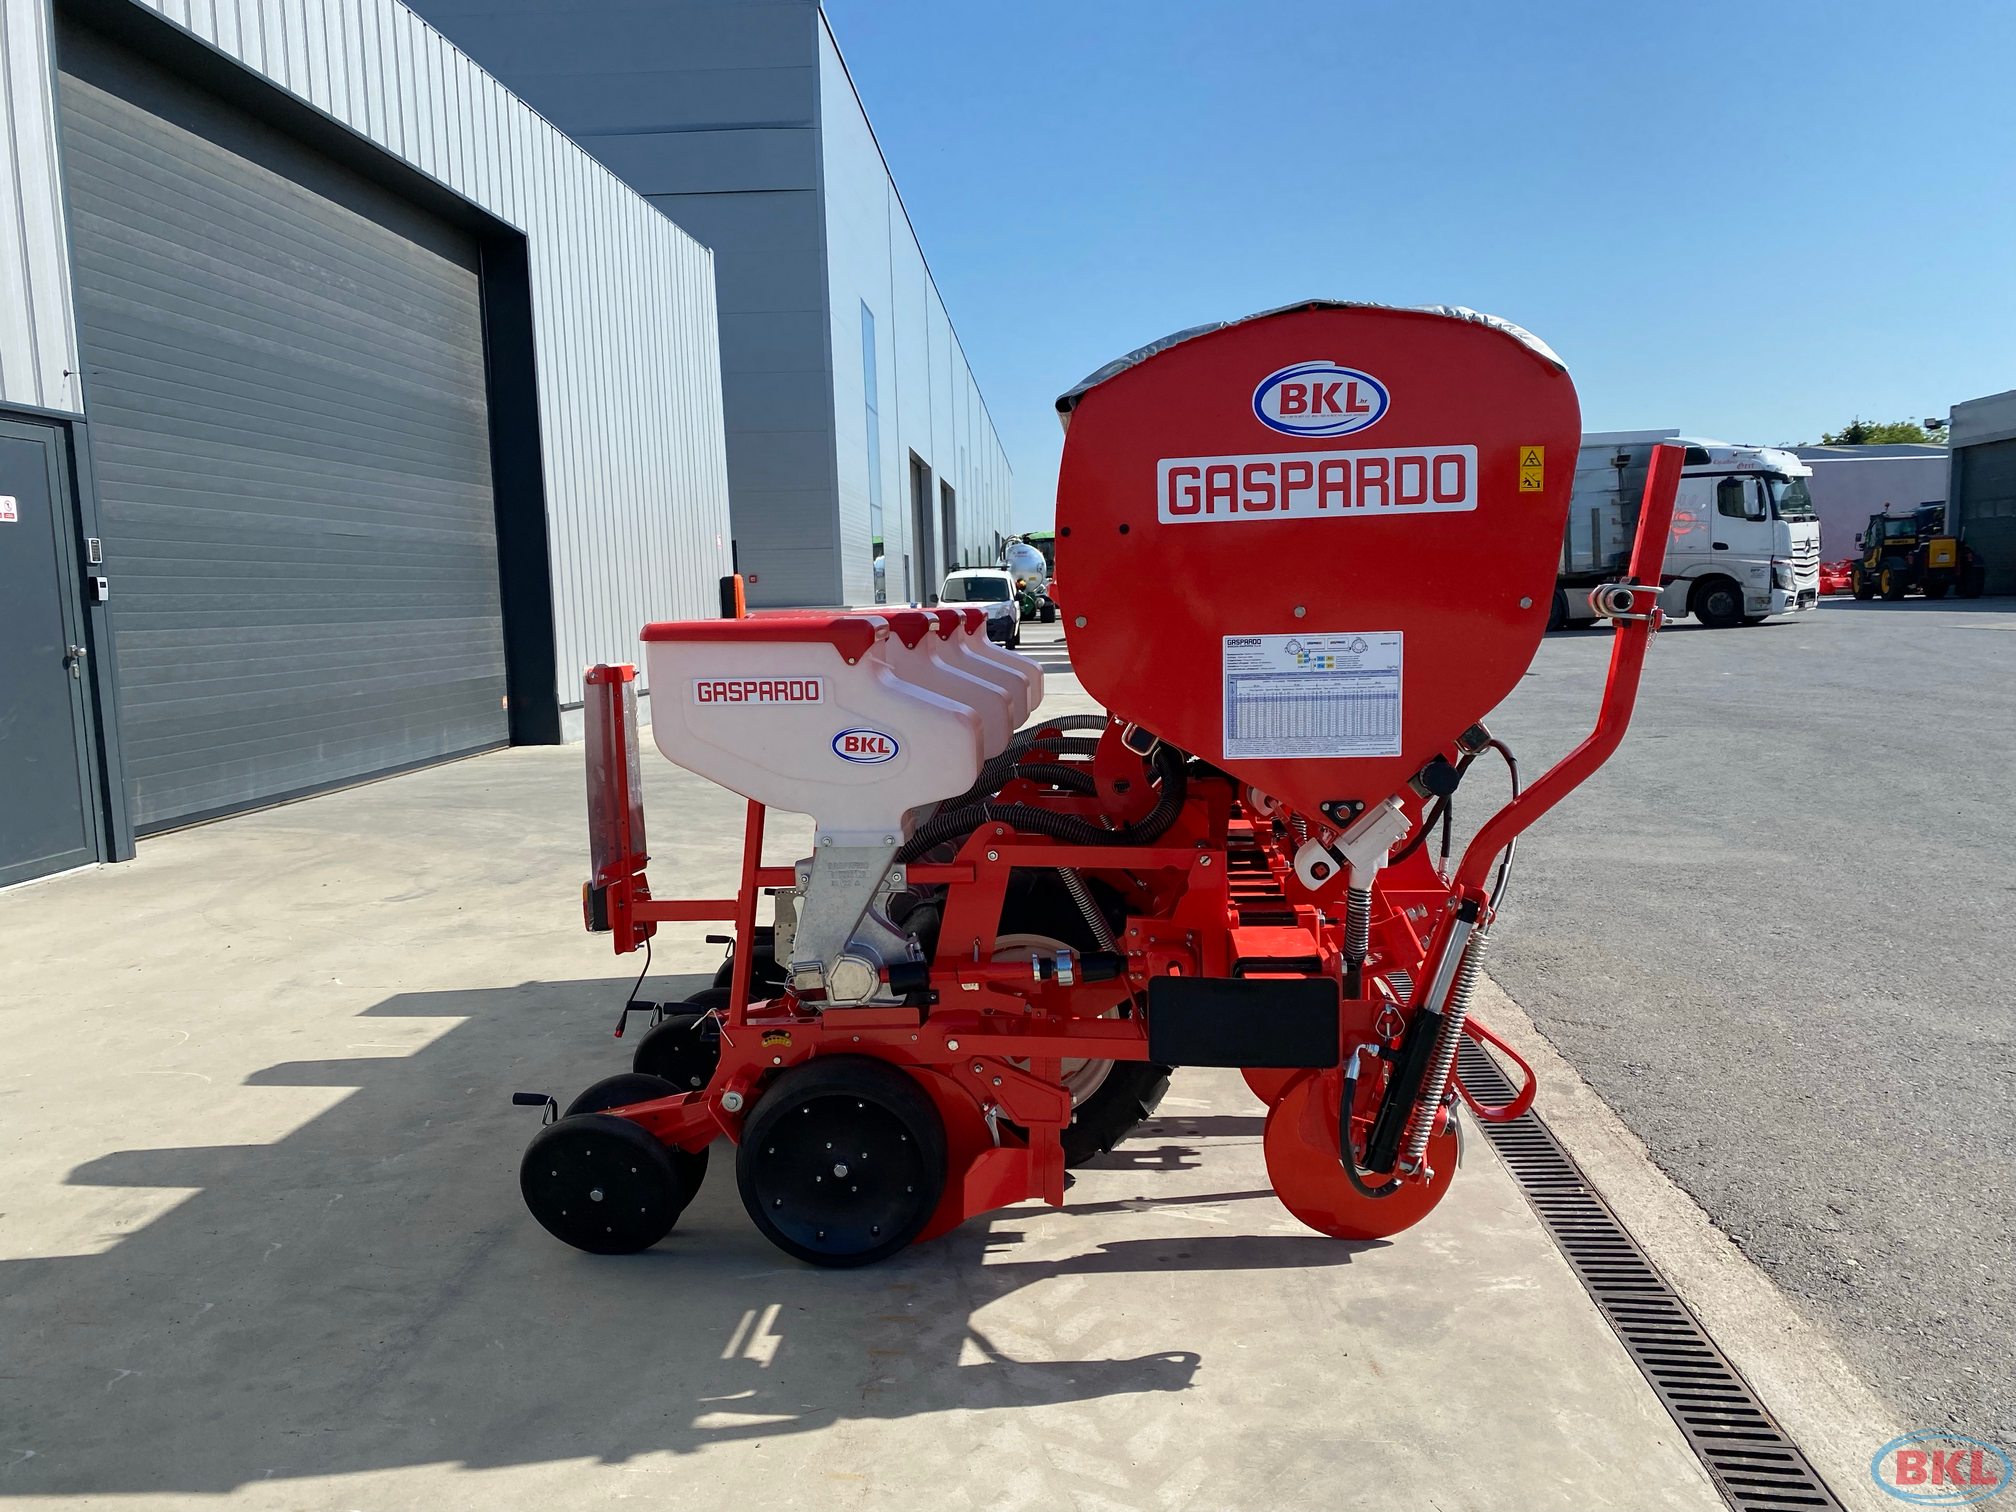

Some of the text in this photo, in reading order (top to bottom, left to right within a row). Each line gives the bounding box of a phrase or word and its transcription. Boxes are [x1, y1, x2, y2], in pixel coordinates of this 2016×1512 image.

[1280, 382, 1370, 415] BKL
[1168, 454, 1467, 516] GASPARDO
[1227, 638, 1262, 646] GASPARDO
[697, 681, 820, 703] GASPARDO
[845, 736, 890, 754] BKL
